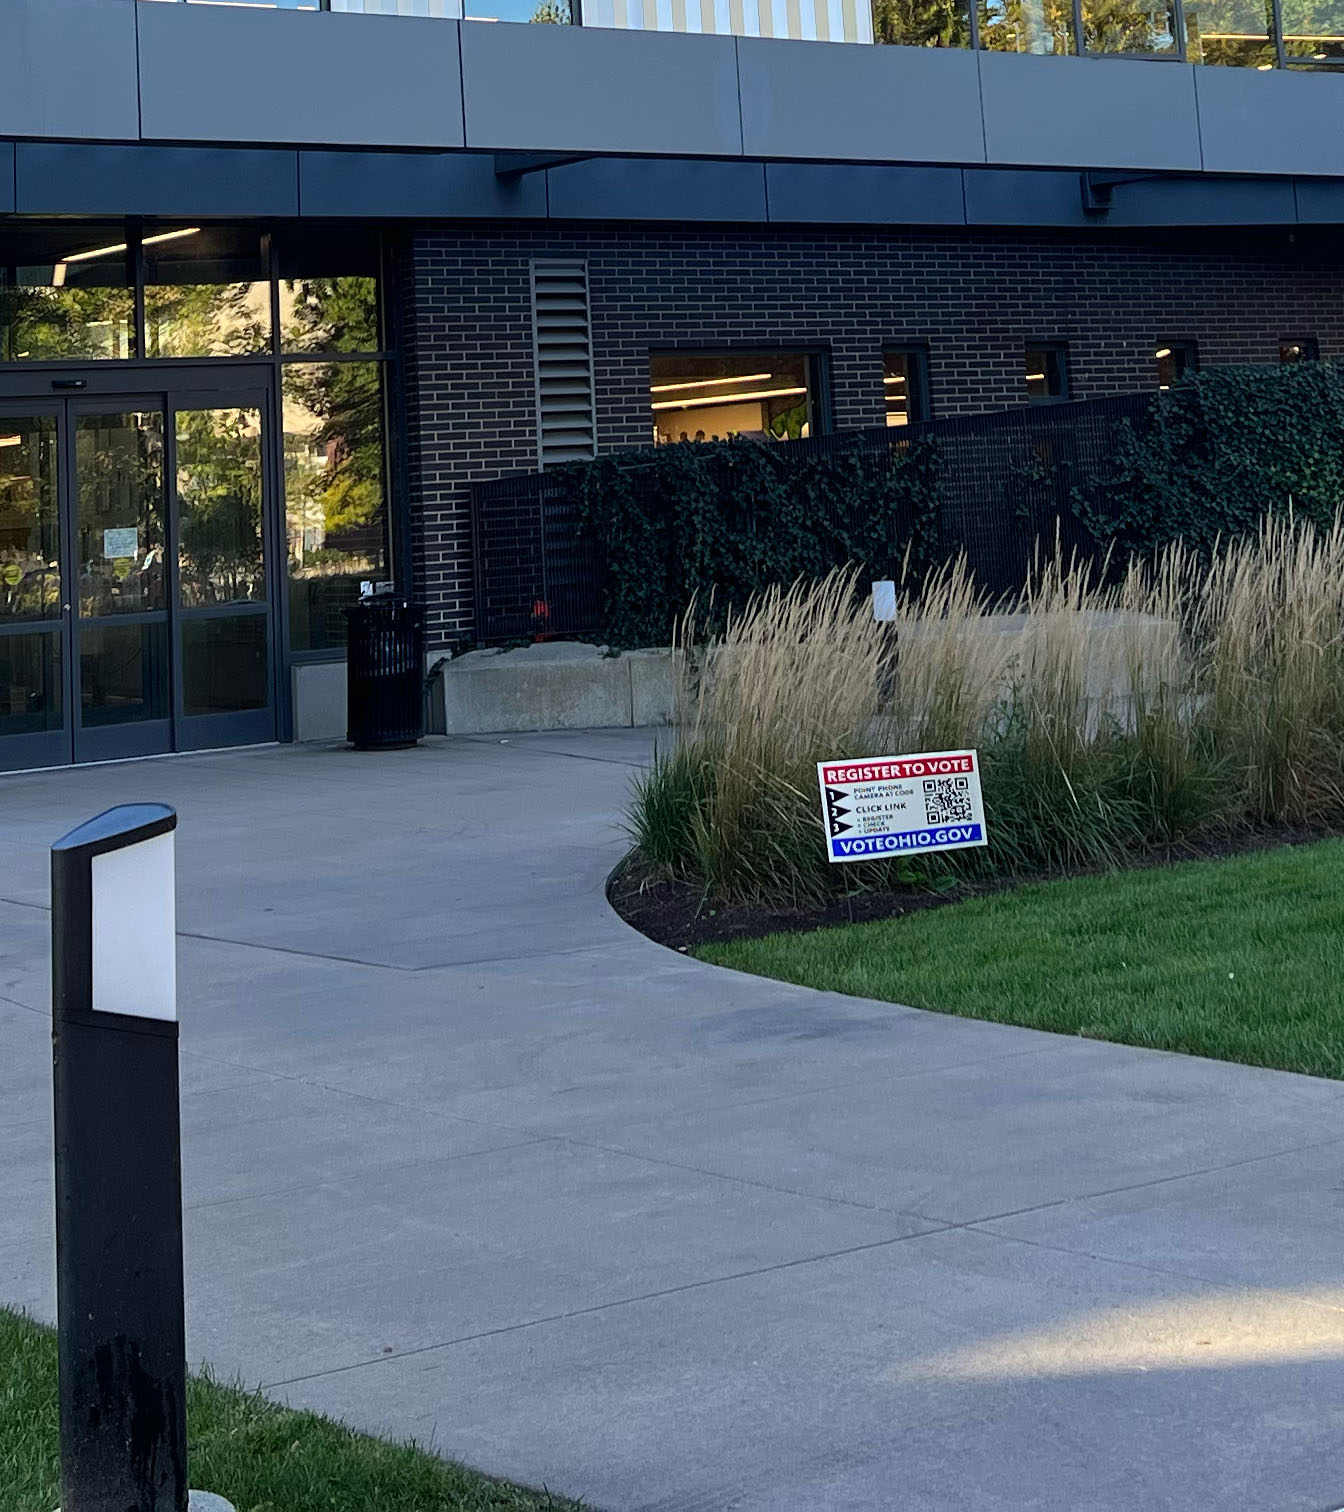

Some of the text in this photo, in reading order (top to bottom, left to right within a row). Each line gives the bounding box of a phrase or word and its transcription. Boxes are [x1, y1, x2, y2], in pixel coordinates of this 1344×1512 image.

[827, 758, 970, 782] REGISTER TO VOTE
[829, 792, 835, 801] 1
[831, 808, 837, 816] 2
[856, 802, 907, 813] CLICK LINK
[833, 824, 839, 832] 3
[840, 828, 972, 853] VOTEOHIO.GOV
